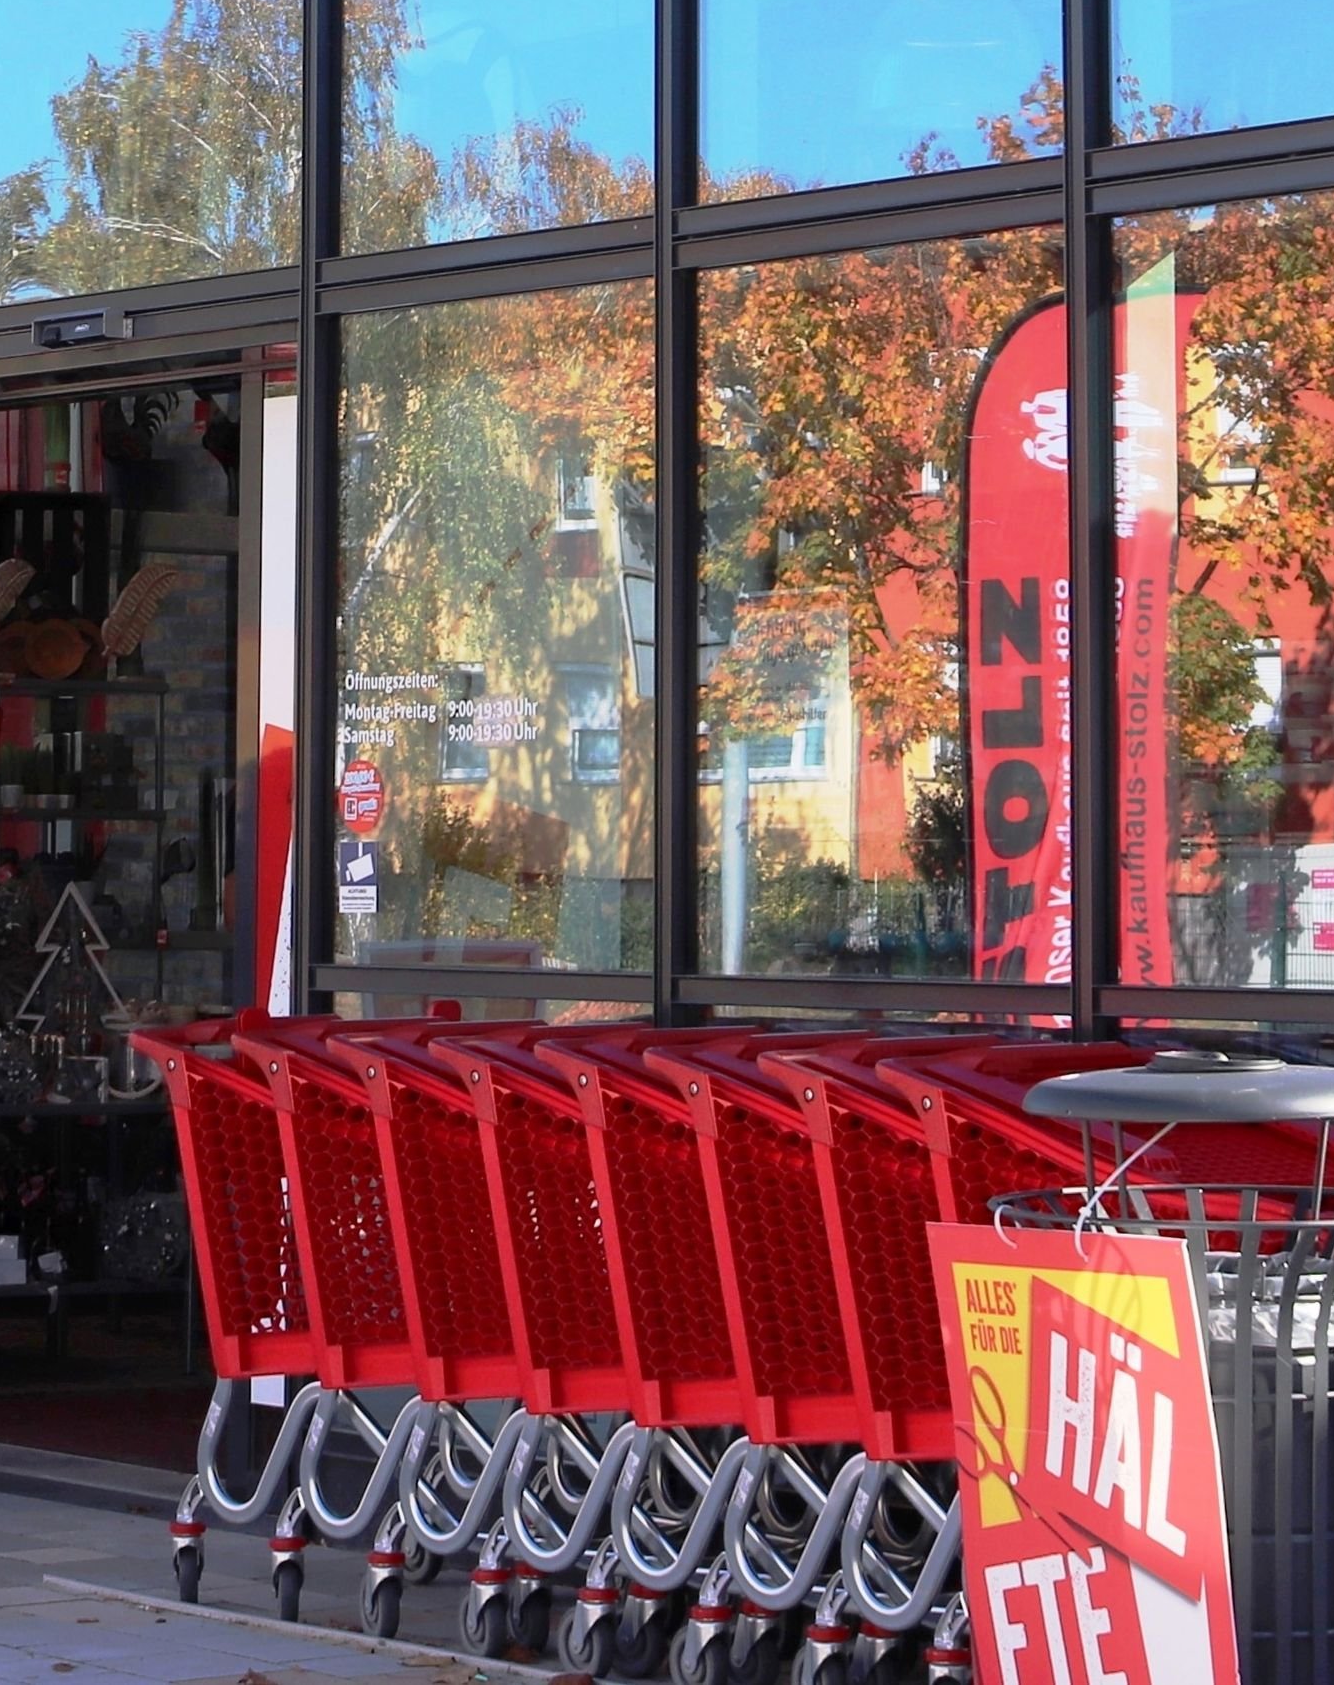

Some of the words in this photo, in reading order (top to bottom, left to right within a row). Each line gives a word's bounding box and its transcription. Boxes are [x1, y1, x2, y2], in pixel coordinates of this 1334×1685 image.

[344, 669, 439, 694] Öffnungszeiten:
[344, 701, 437, 724] Montag-Freitag
[514, 698, 538, 717] Uhr
[344, 726, 395, 746] Samstag
[514, 722, 538, 740] Uhr
[969, 1318, 999, 1354] FÜR
[999, 1325, 1023, 1356] DIE
[1044, 1329, 1187, 1558] HÄL
